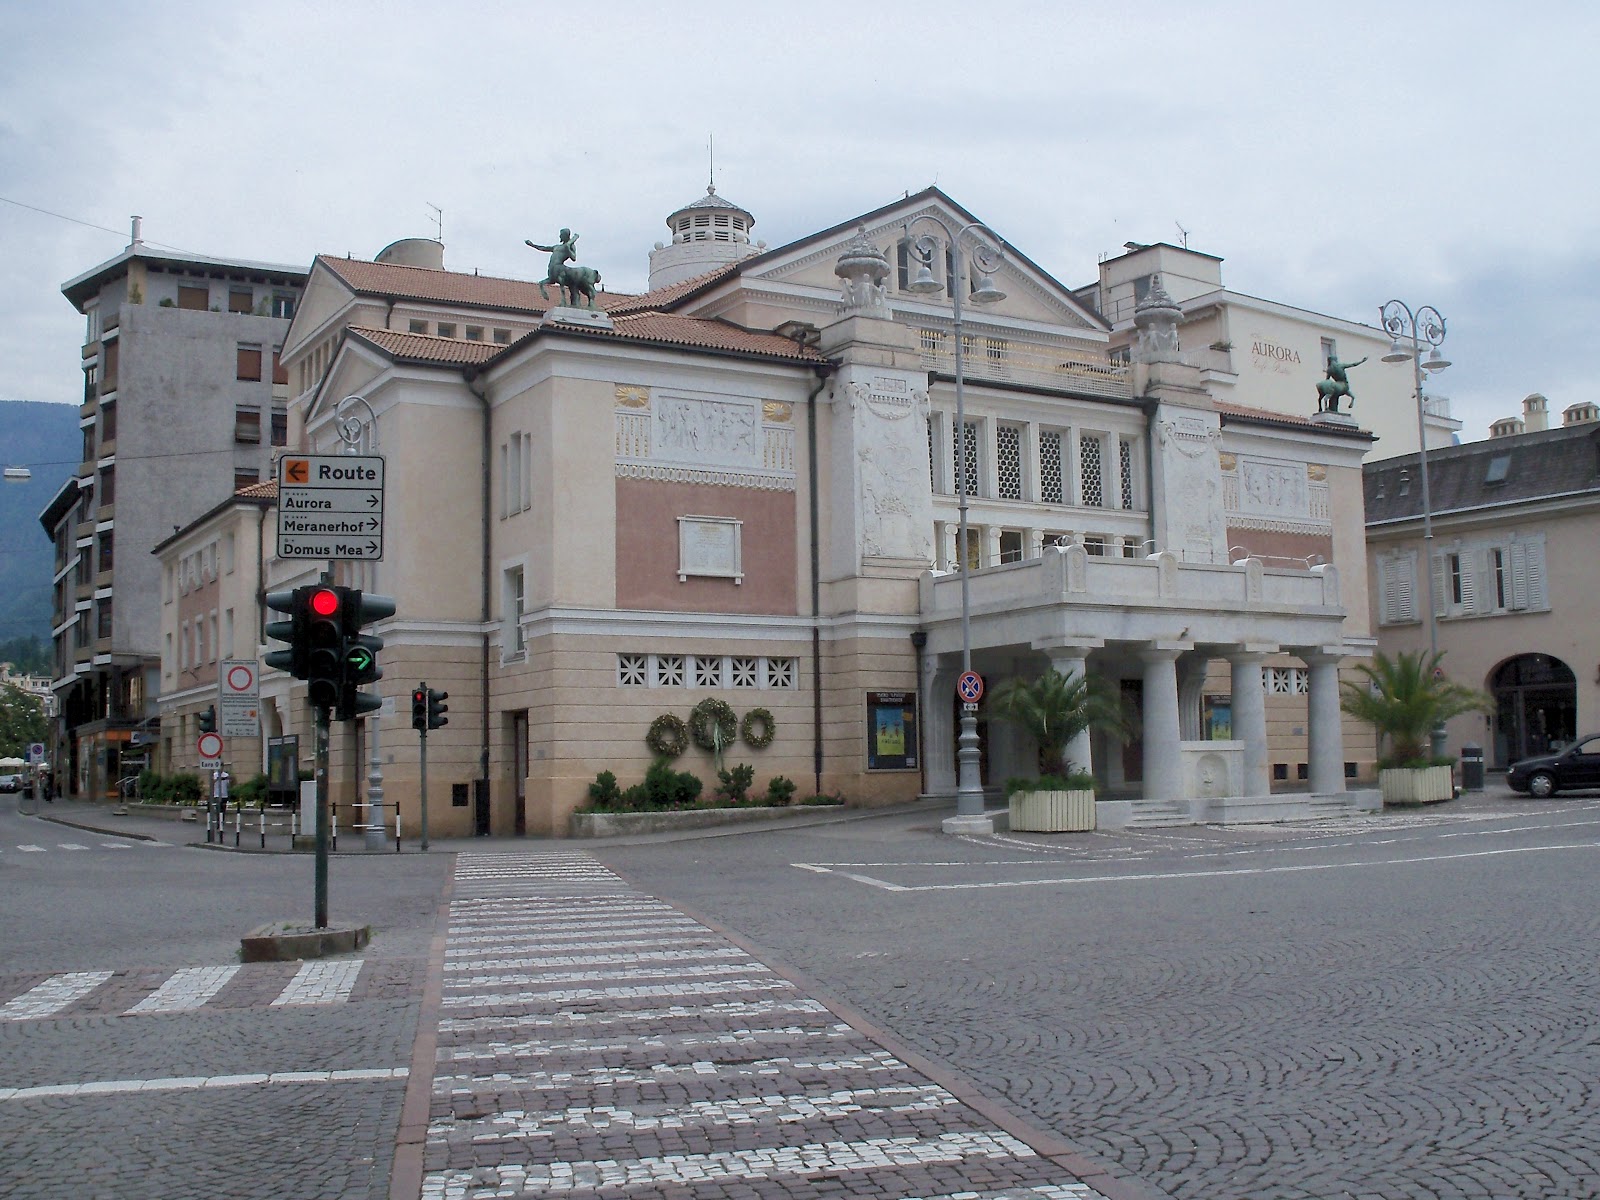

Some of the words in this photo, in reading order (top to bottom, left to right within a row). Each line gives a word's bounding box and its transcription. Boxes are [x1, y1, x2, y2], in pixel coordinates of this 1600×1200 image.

[1252, 342, 1301, 363] AURORA
[319, 465, 376, 480] Route
[285, 498, 331, 508] Aurora
[284, 521, 363, 532] Meranerhof
[284, 544, 330, 555] Domus
[335, 545, 363, 555] Mea
